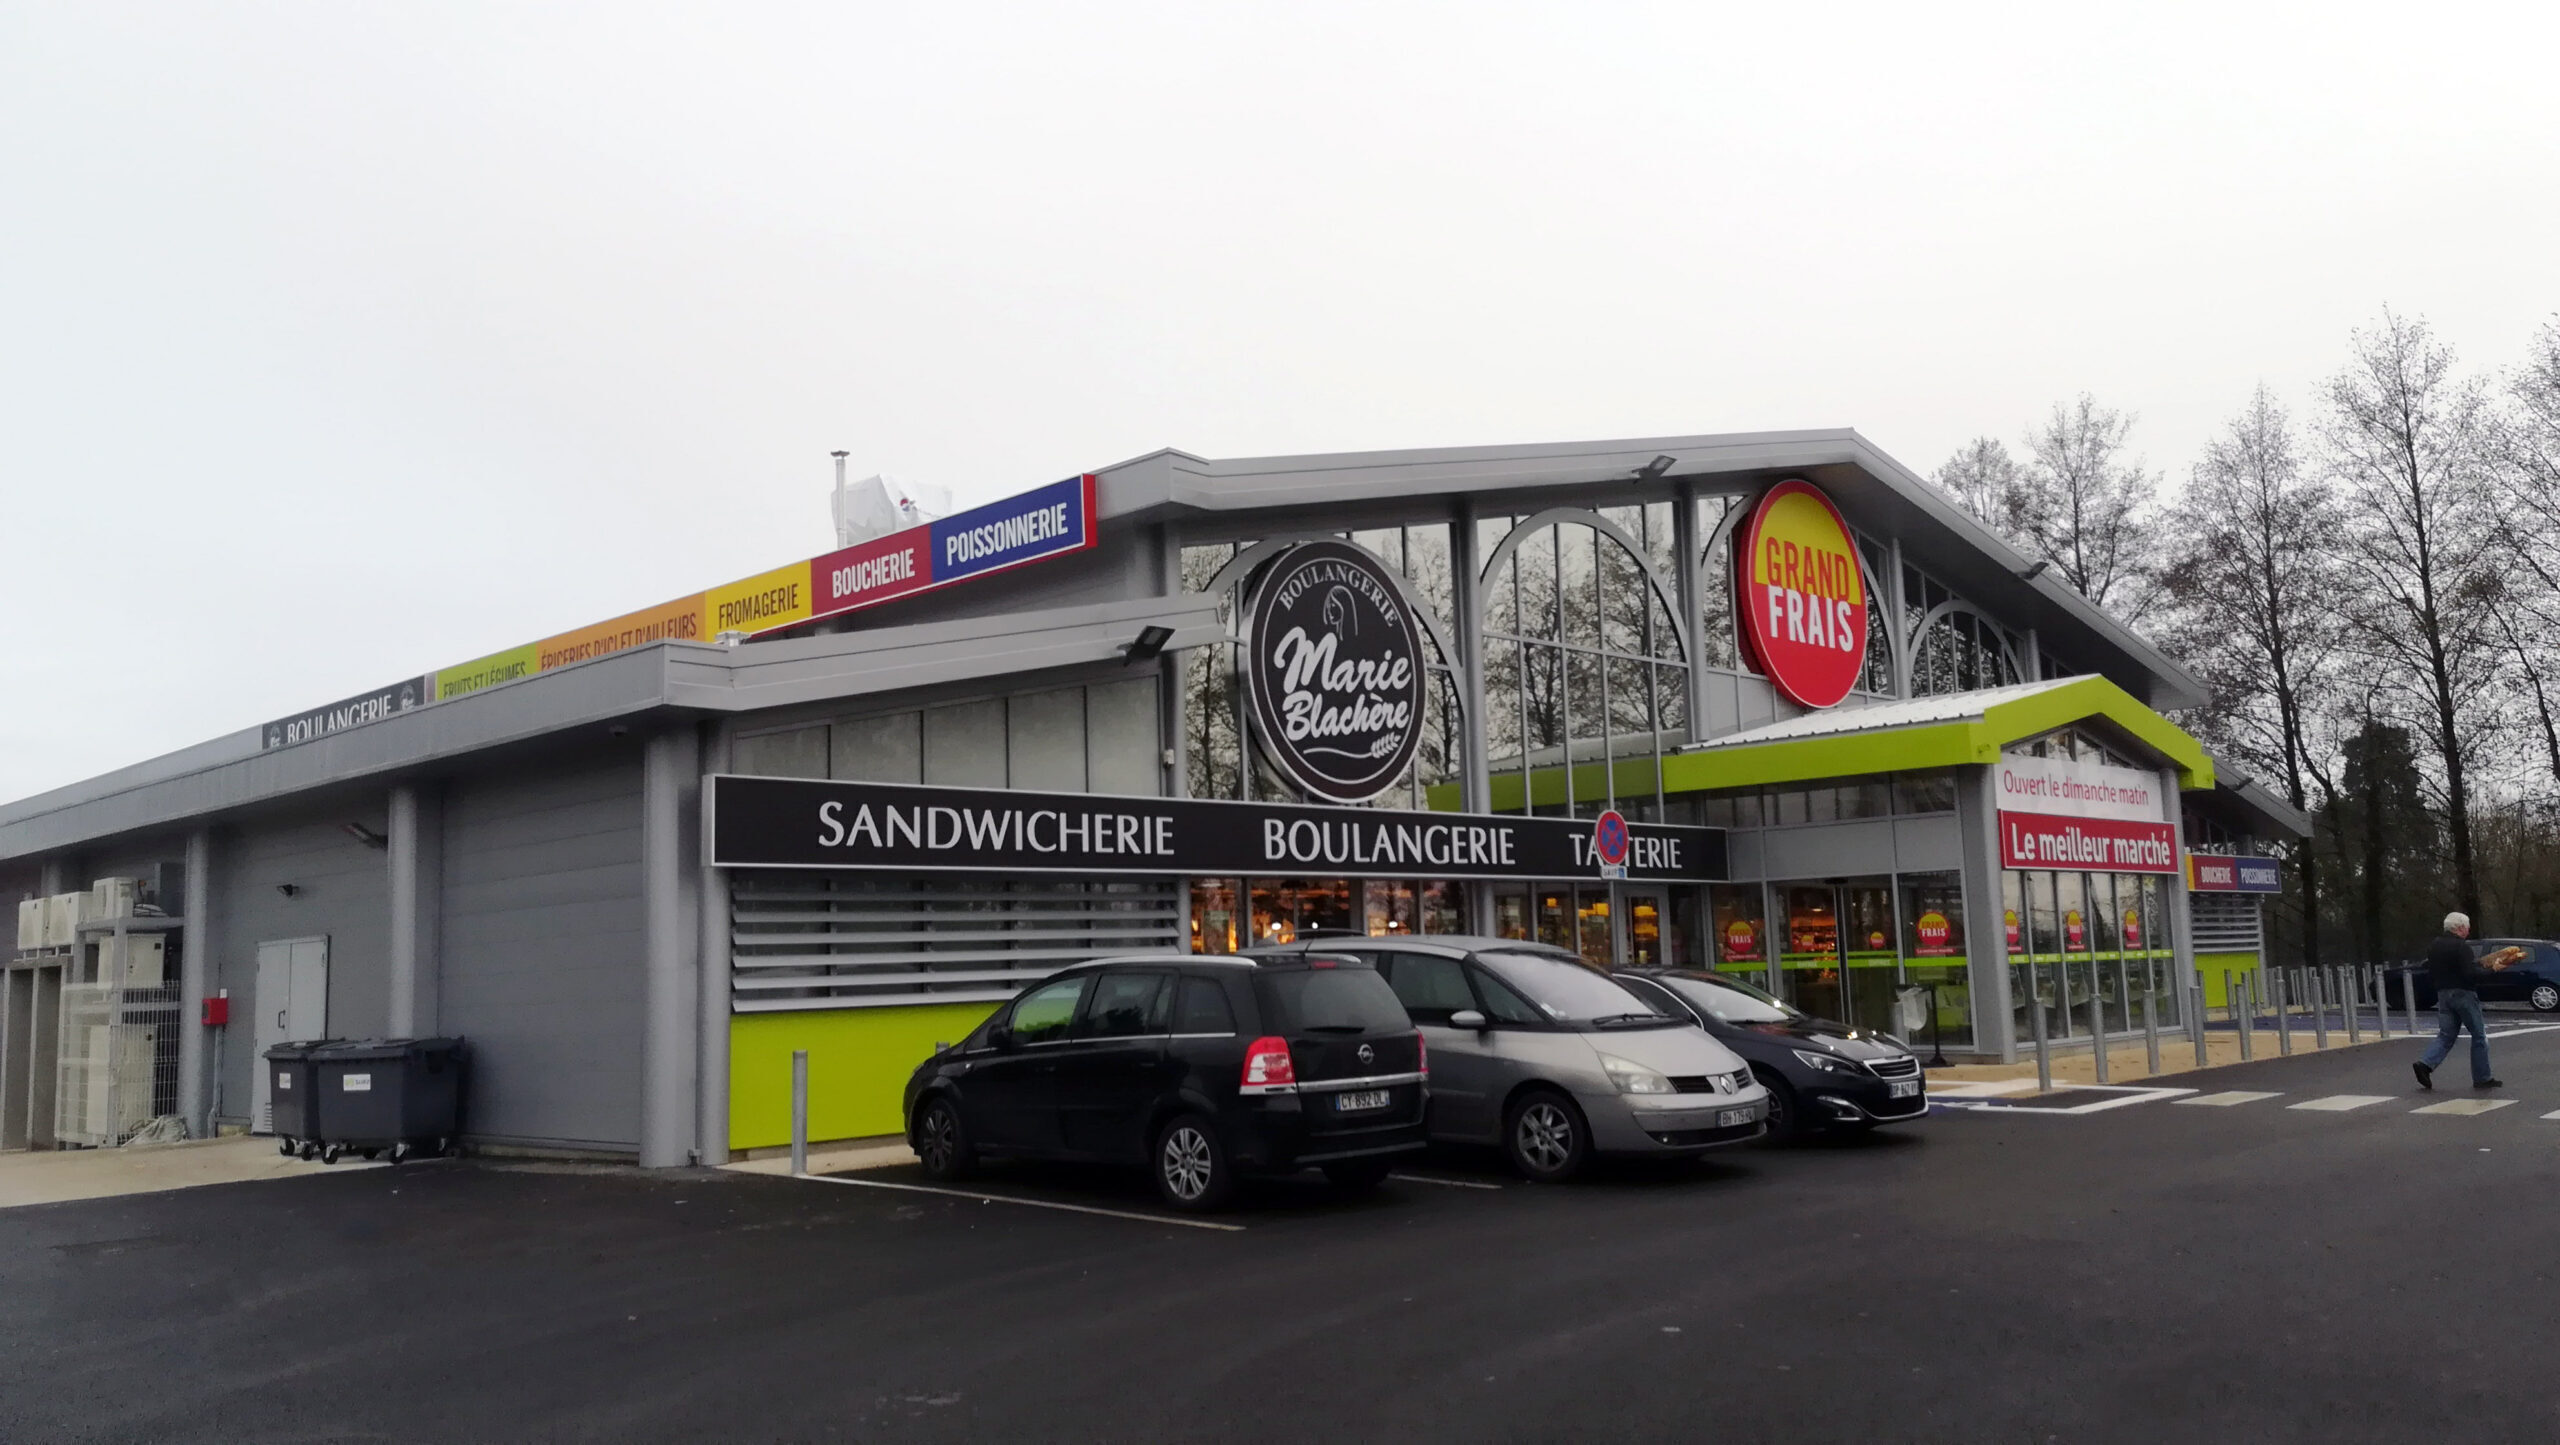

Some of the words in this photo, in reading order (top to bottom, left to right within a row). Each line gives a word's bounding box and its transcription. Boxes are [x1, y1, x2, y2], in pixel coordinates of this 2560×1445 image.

[946, 502, 1069, 567] POISSONNERIE
[832, 548, 916, 599] BOUCHERIE
[1766, 536, 1849, 602] GRAND
[718, 583, 799, 630] FROMAGERIE
[1279, 564, 1400, 628] BOULANGERIE
[1768, 584, 1854, 652] FRAIS
[1274, 626, 1412, 694] Marie
[1282, 690, 1410, 741] Blachère
[2003, 769, 2047, 797] Ouvert
[2048, 773, 2060, 798] le
[2062, 777, 2117, 803] dimanche
[2119, 784, 2149, 806] matin
[818, 801, 1175, 856] SANDWICHERIE
[1264, 818, 1516, 866] BOULANGERIE
[1568, 833, 1683, 869] TAERIE
[2011, 823, 2035, 860] Le
[2039, 827, 2110, 864] meilleur
[2114, 829, 2171, 867] marché
[1730, 934, 1752, 945] FRAIS
[1922, 928, 1946, 937] FRAIS
